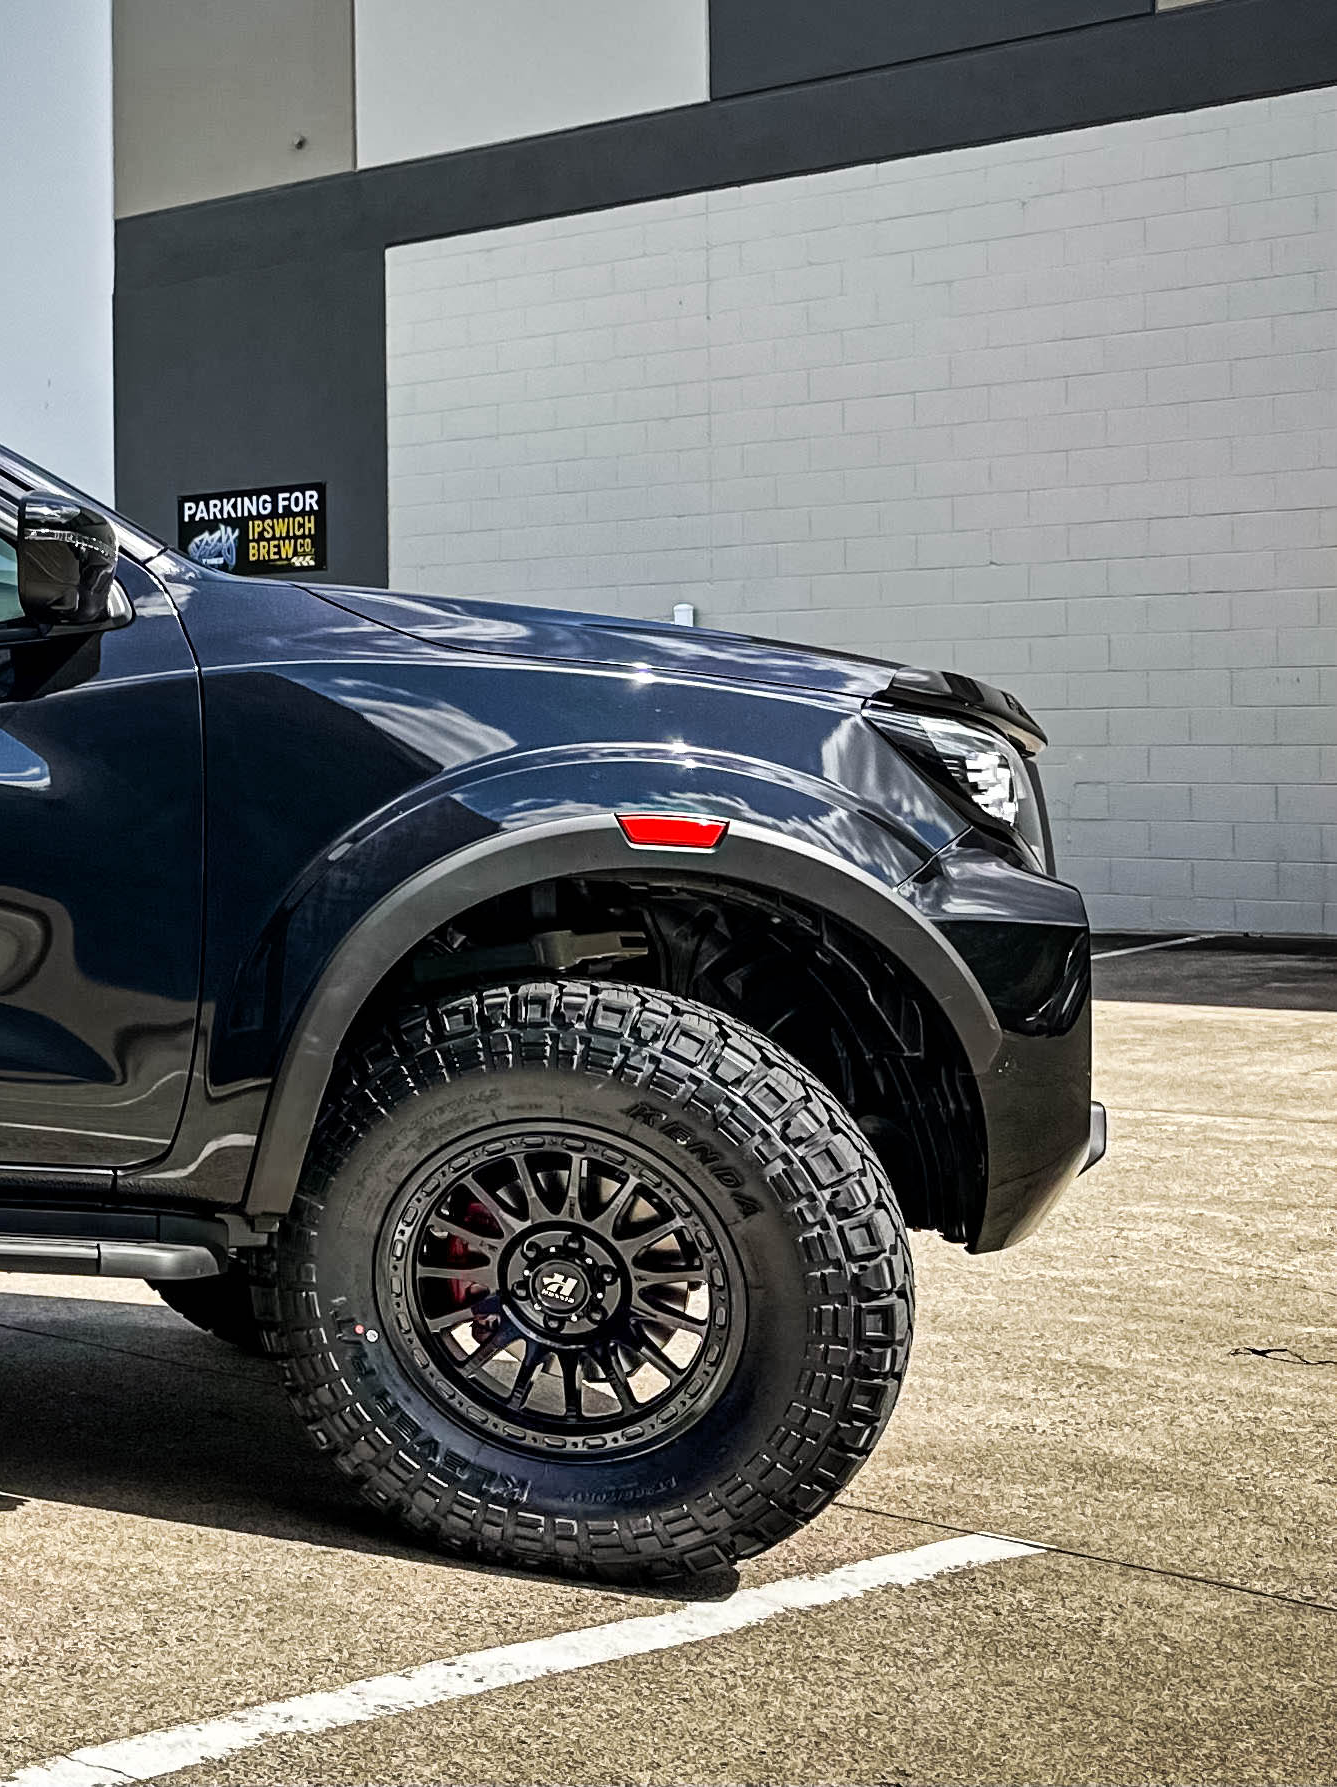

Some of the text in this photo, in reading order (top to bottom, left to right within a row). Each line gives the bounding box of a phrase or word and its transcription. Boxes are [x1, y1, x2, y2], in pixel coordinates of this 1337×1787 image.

[183, 490, 319, 522] PARKING FOR
[248, 515, 315, 540] IPSWICH
[248, 539, 294, 561] BREW
[619, 1101, 765, 1219] KENDA
